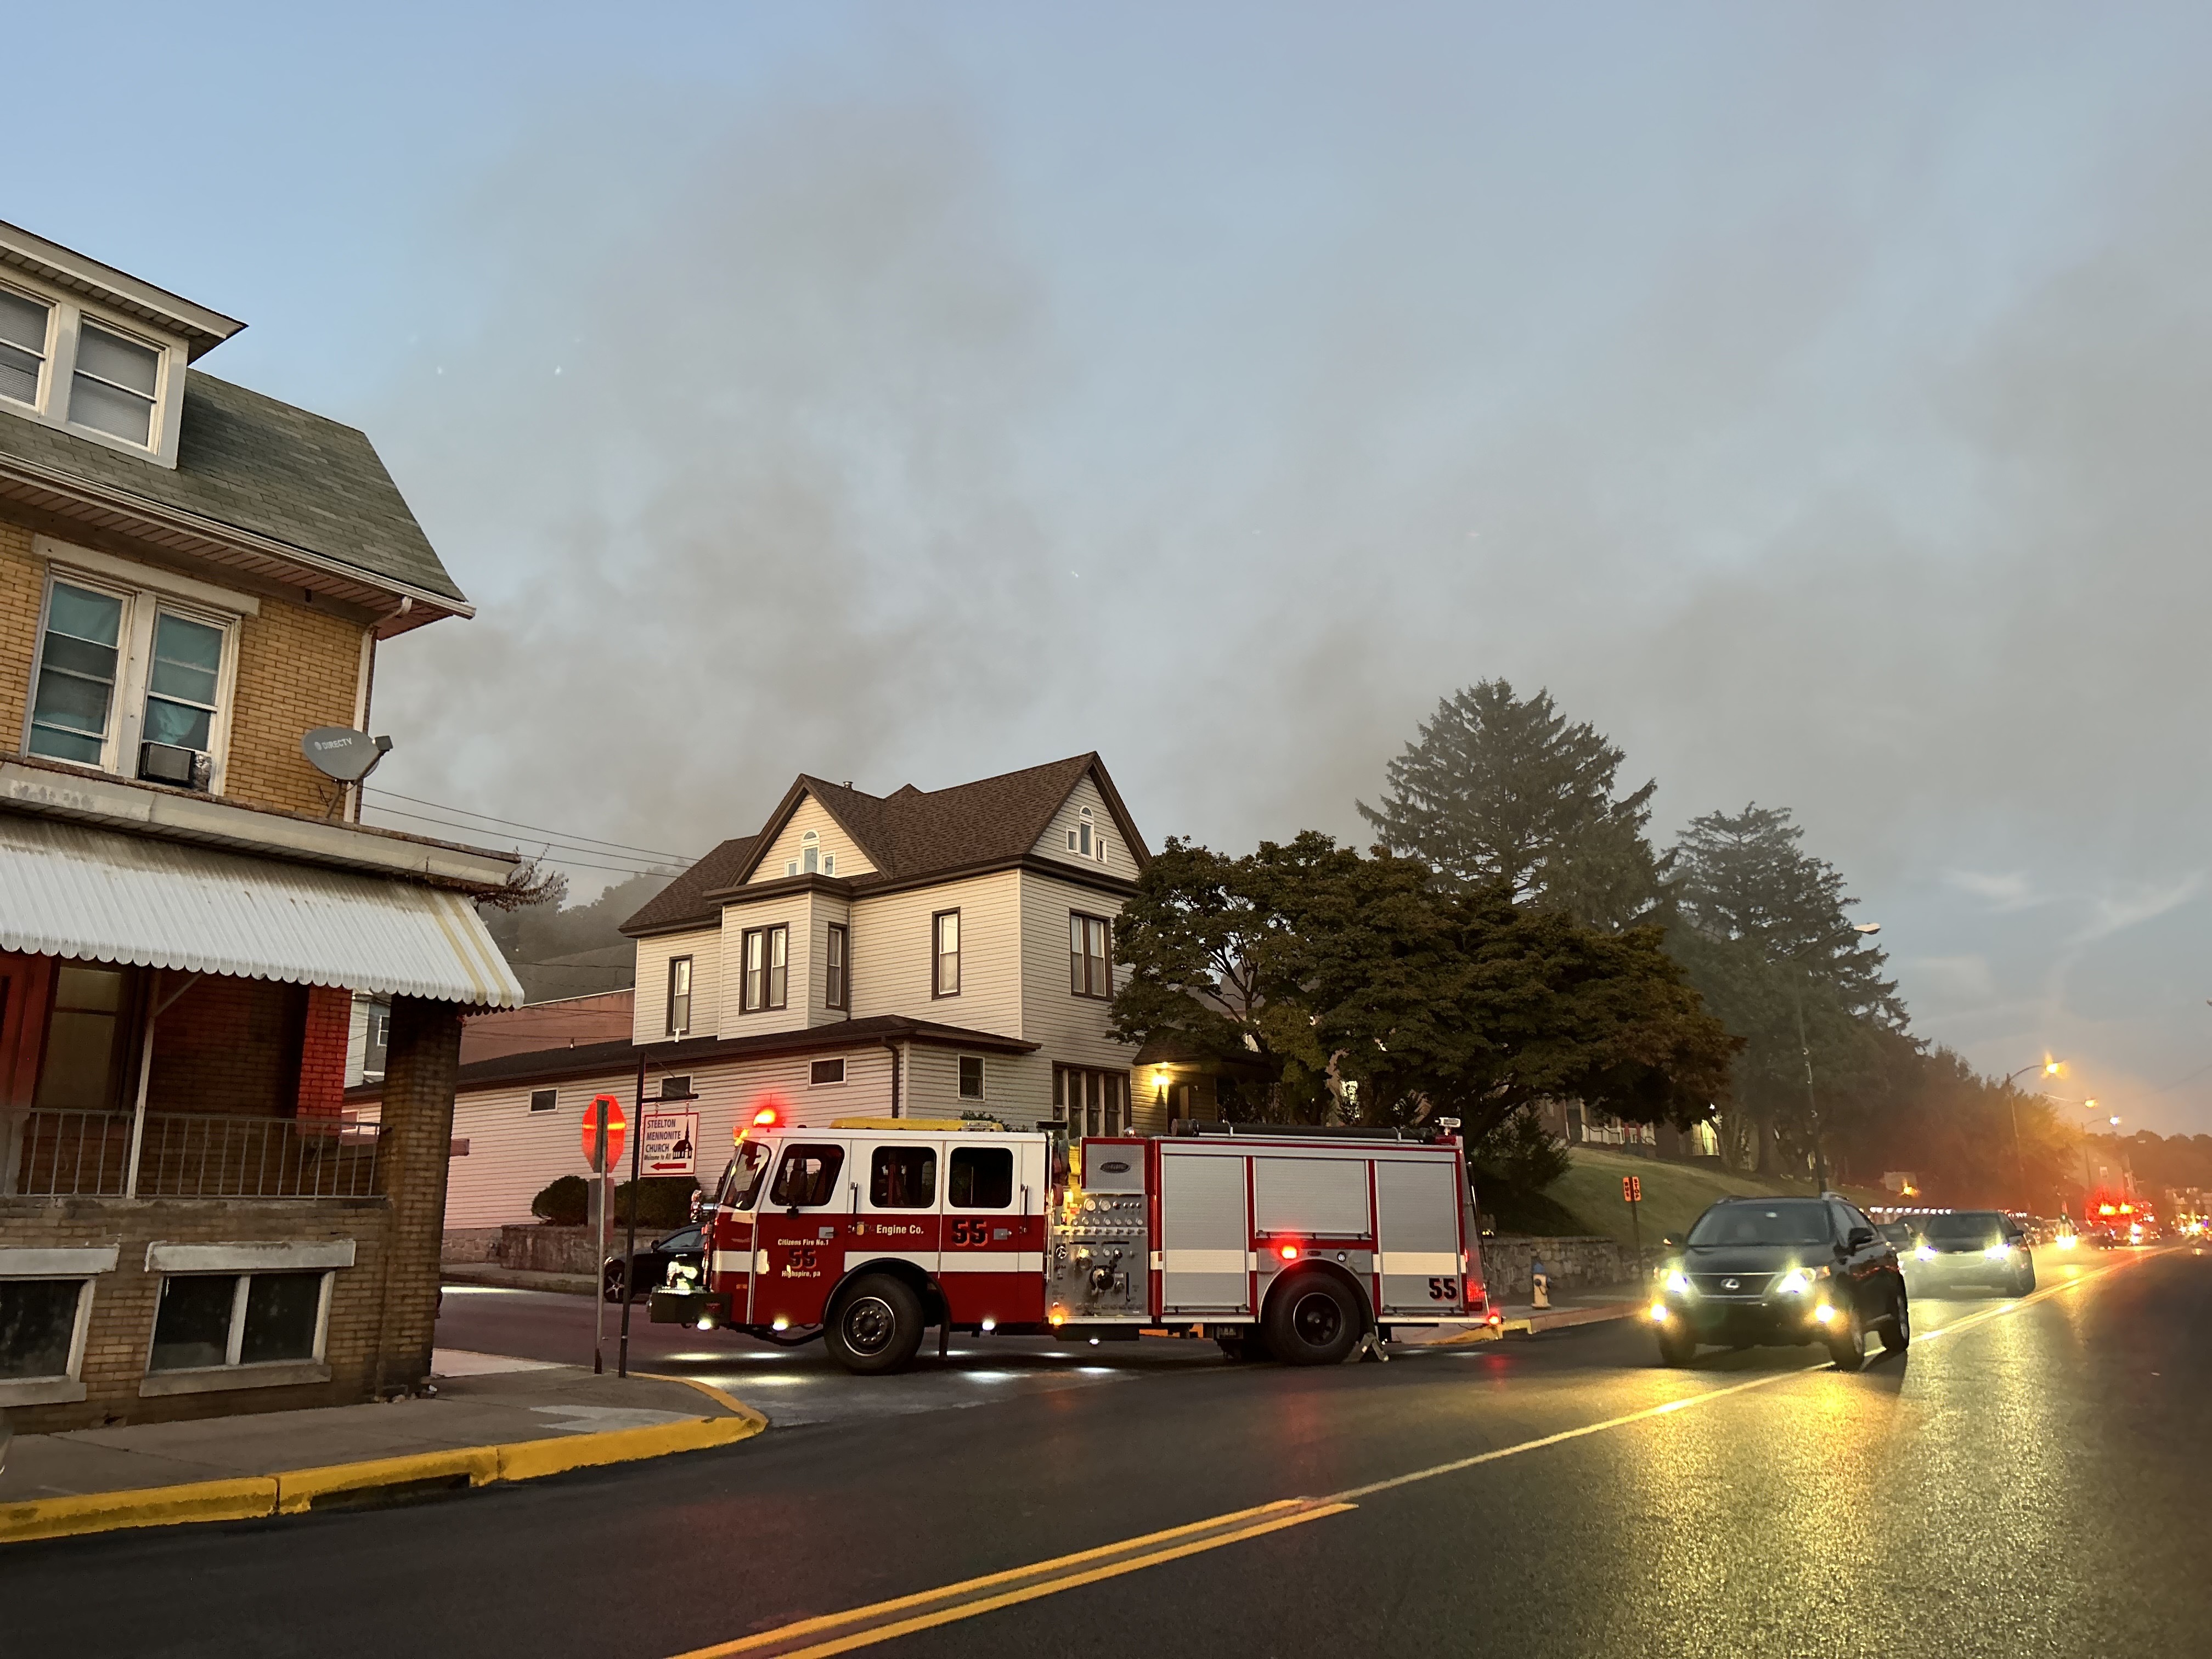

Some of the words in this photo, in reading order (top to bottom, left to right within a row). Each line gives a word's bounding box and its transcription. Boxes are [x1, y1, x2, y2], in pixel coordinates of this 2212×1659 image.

[321, 737, 352, 749] DIRECTV
[647, 1119, 676, 1128] STEELTON
[646, 1131, 681, 1141] MENNONITE
[646, 1143, 669, 1153] CHURCH
[876, 1224, 907, 1235] Engine
[909, 1224, 924, 1234] Co.
[951, 1218, 988, 1247] 55
[788, 1248, 817, 1269] 55
[1429, 1277, 1458, 1301] 55
